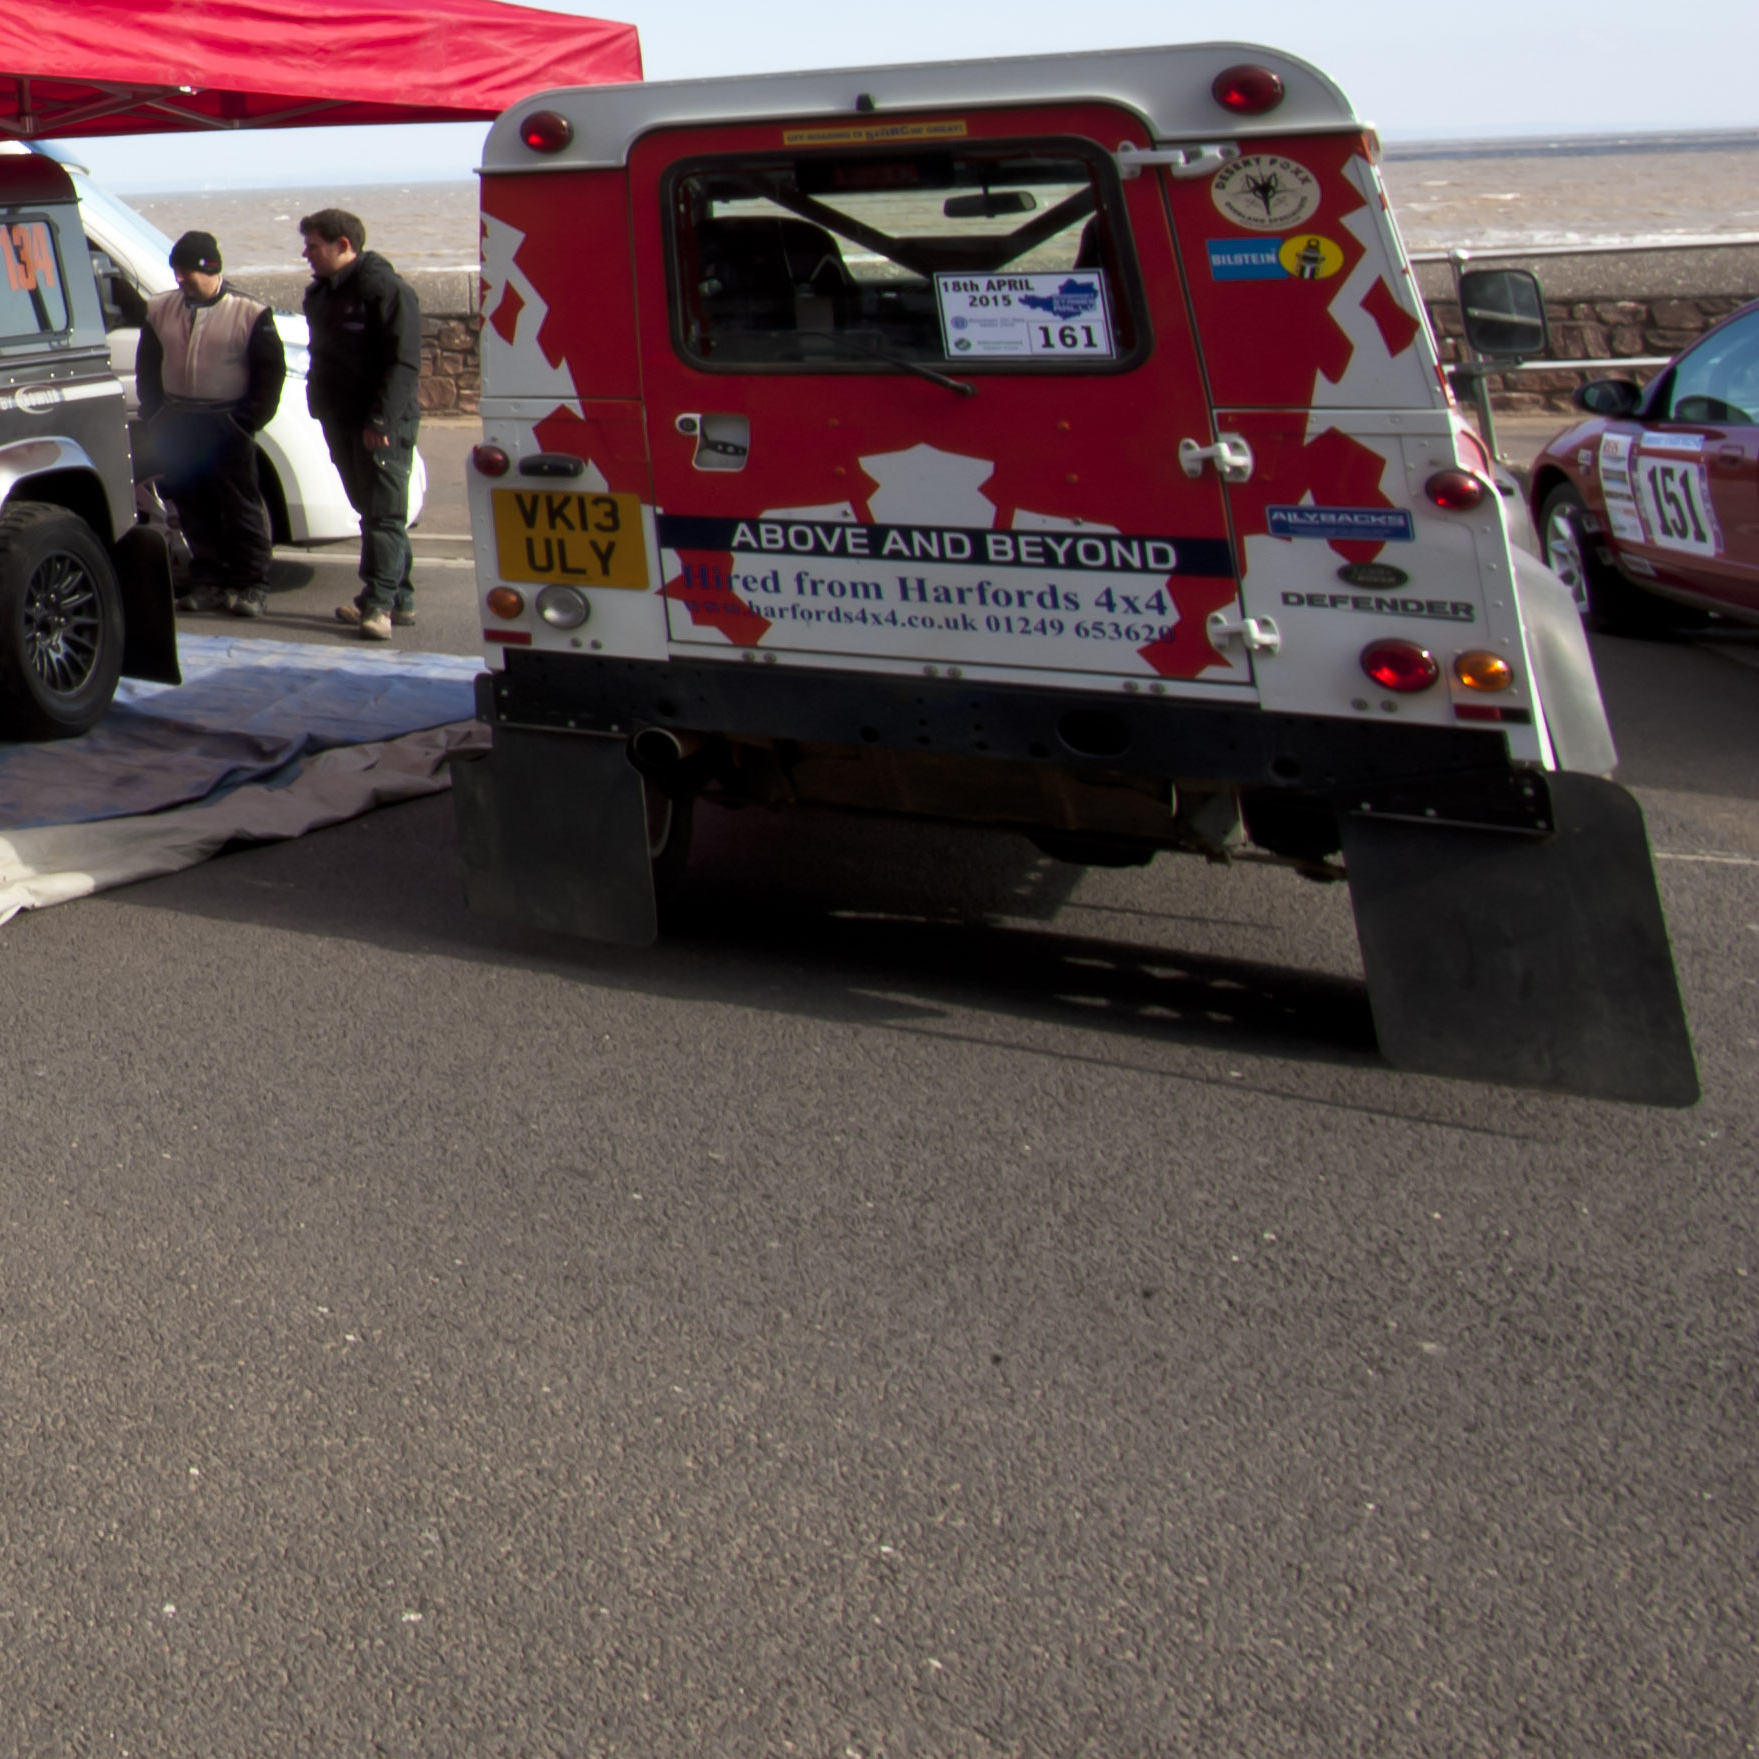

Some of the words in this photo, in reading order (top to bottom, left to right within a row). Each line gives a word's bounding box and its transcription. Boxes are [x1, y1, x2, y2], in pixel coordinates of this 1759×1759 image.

[1211, 252, 1277, 266] BILSTEIN
[942, 279, 980, 293] 18th
[985, 278, 1035, 292] APRIL
[968, 294, 1012, 307] 2015
[1038, 324, 1098, 349] 161
[0, 395, 13, 410] BY
[515, 493, 621, 533] VK13
[1647, 464, 1707, 544] 151
[524, 535, 616, 577] ULY
[730, 522, 870, 555] ABOVE
[881, 529, 972, 559] AND
[985, 533, 1178, 571] BEYOND
[682, 563, 782, 596] Hired
[795, 570, 883, 601] from
[897, 576, 1081, 613] Harfords
[1094, 585, 1168, 617] 4x4
[1281, 591, 1475, 619] DEFENDER
[684, 598, 979, 633] www.harfords4x4.co.uk
[985, 614, 1065, 638] 01249
[1073, 619, 1176, 645] 653620
